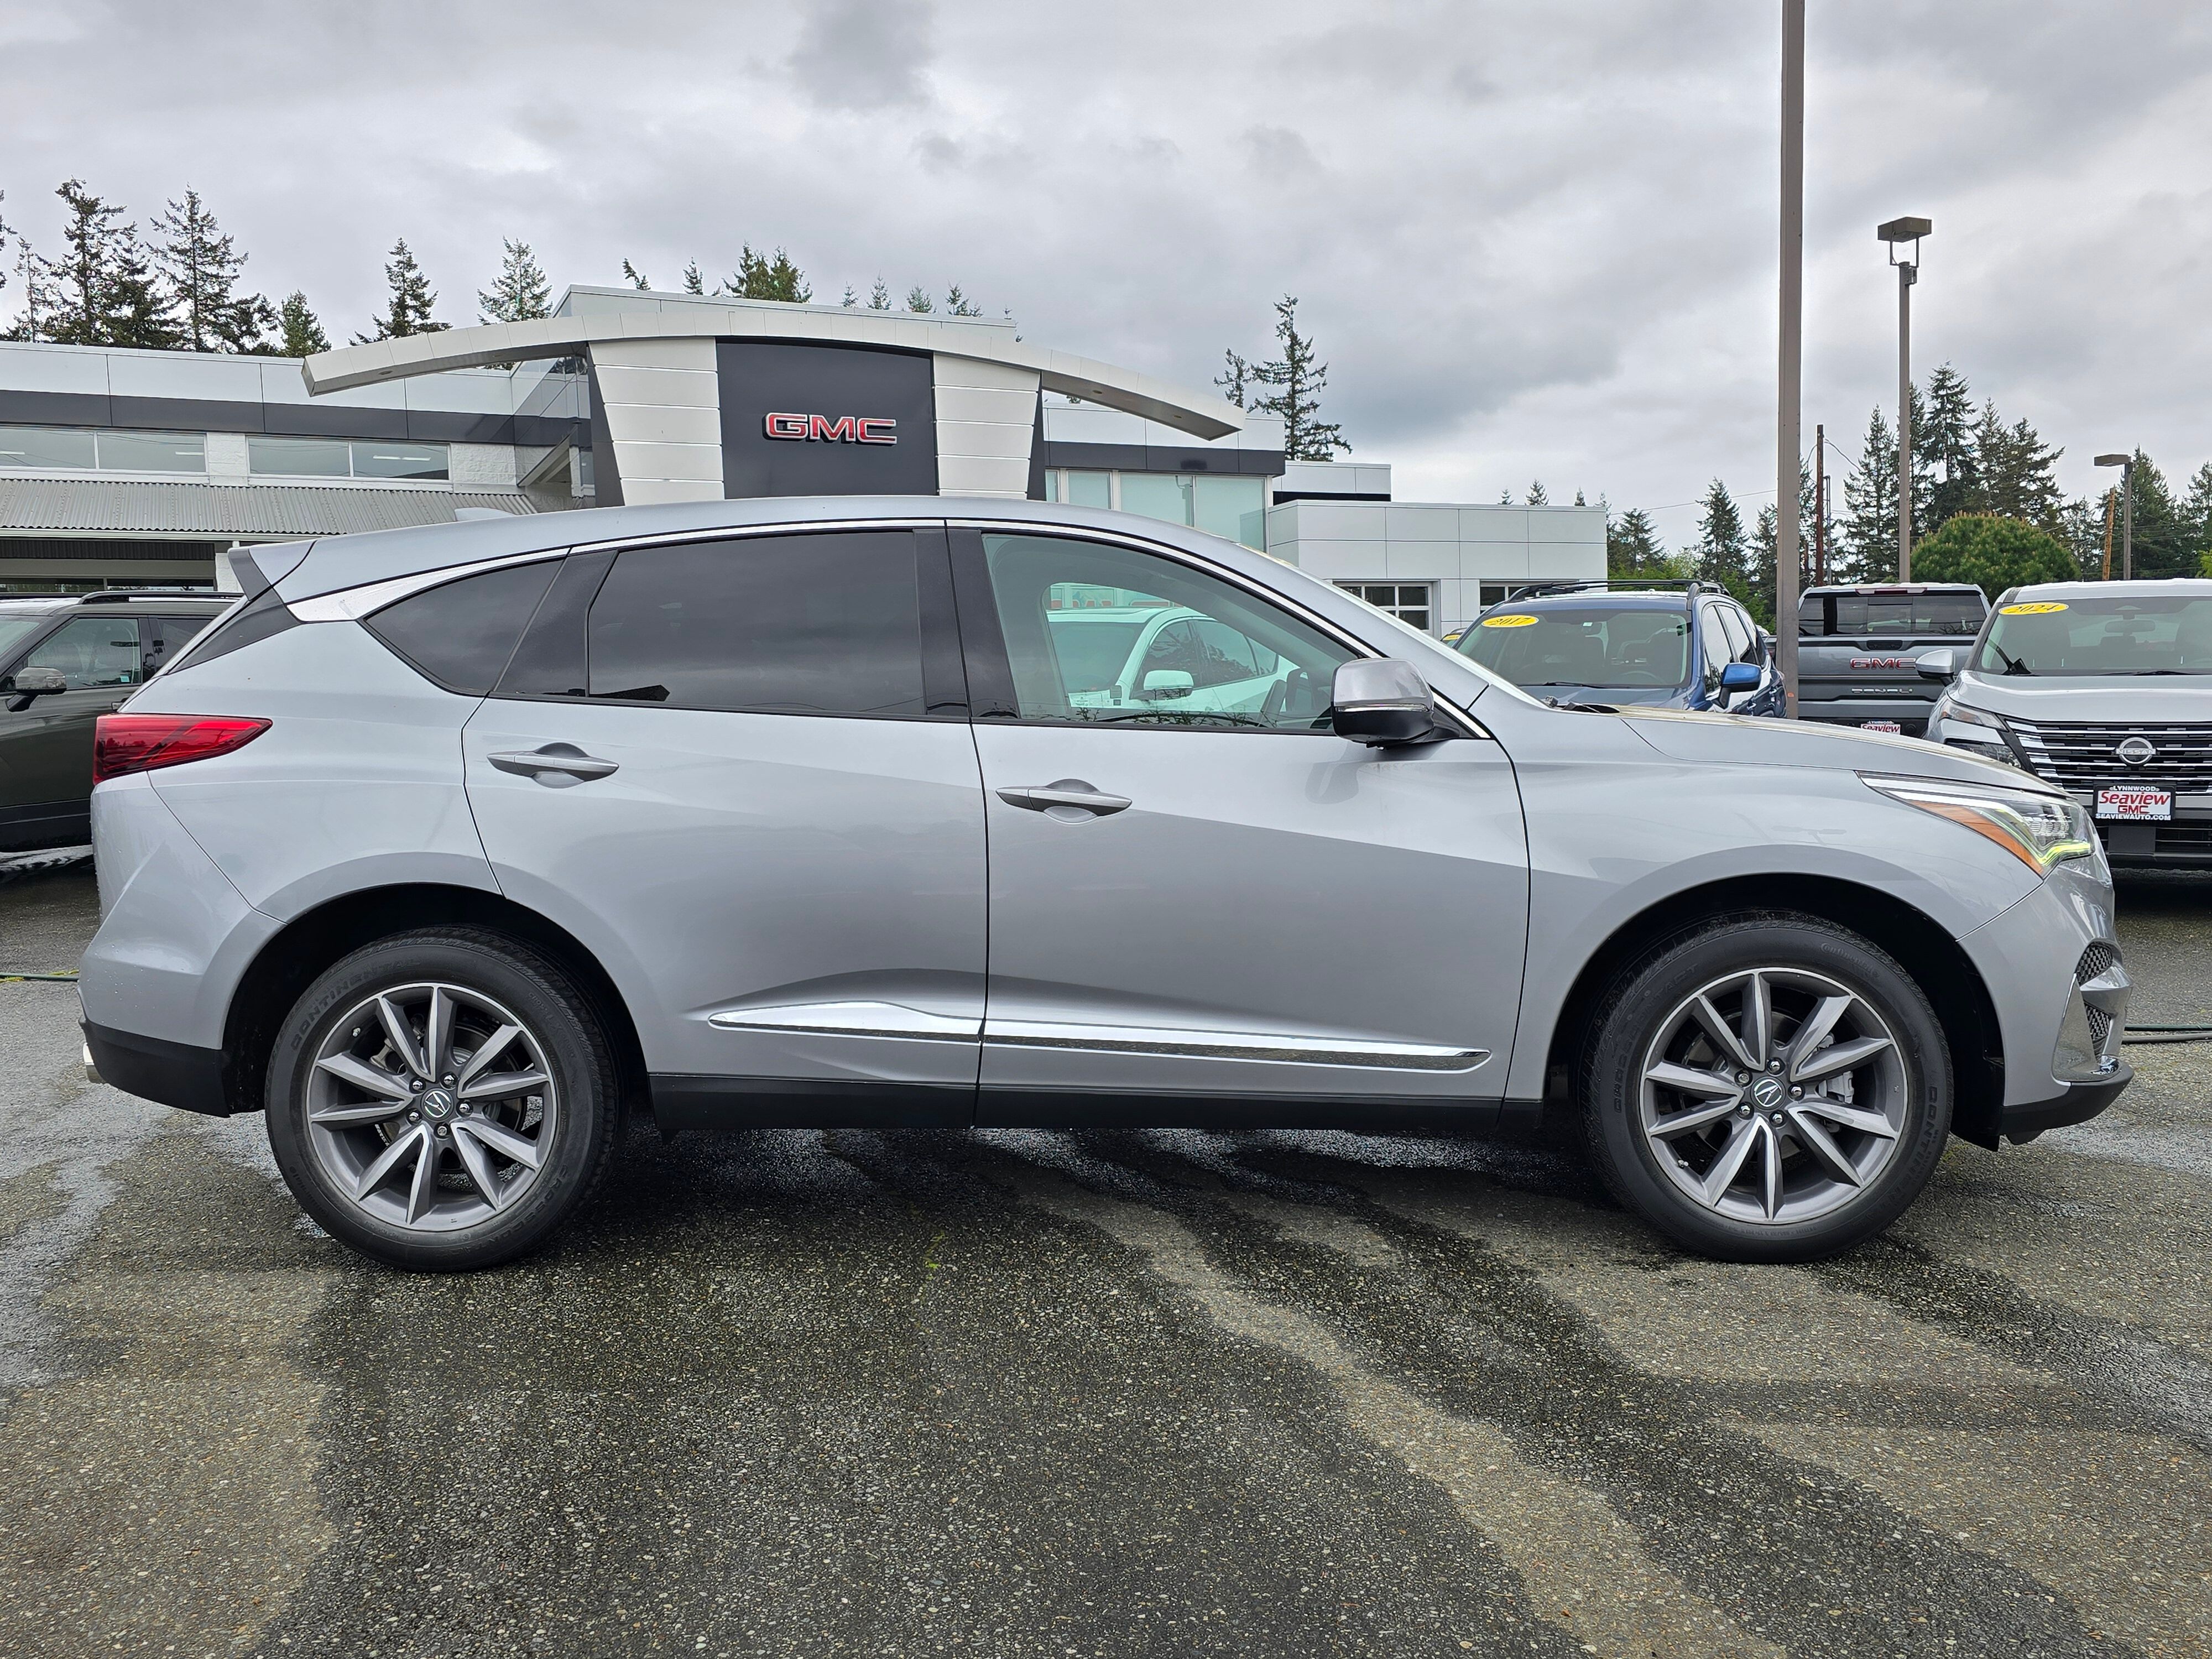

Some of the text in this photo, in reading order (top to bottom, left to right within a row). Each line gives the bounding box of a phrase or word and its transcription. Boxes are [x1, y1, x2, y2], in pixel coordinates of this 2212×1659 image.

[765, 412, 897, 444] GMC
[2007, 604, 2060, 614] 2024
[1489, 617, 1532, 625] 2017
[1850, 658, 1916, 670] GMC
[2099, 791, 2171, 805] Seaview
[2117, 805, 2150, 814] GMC
